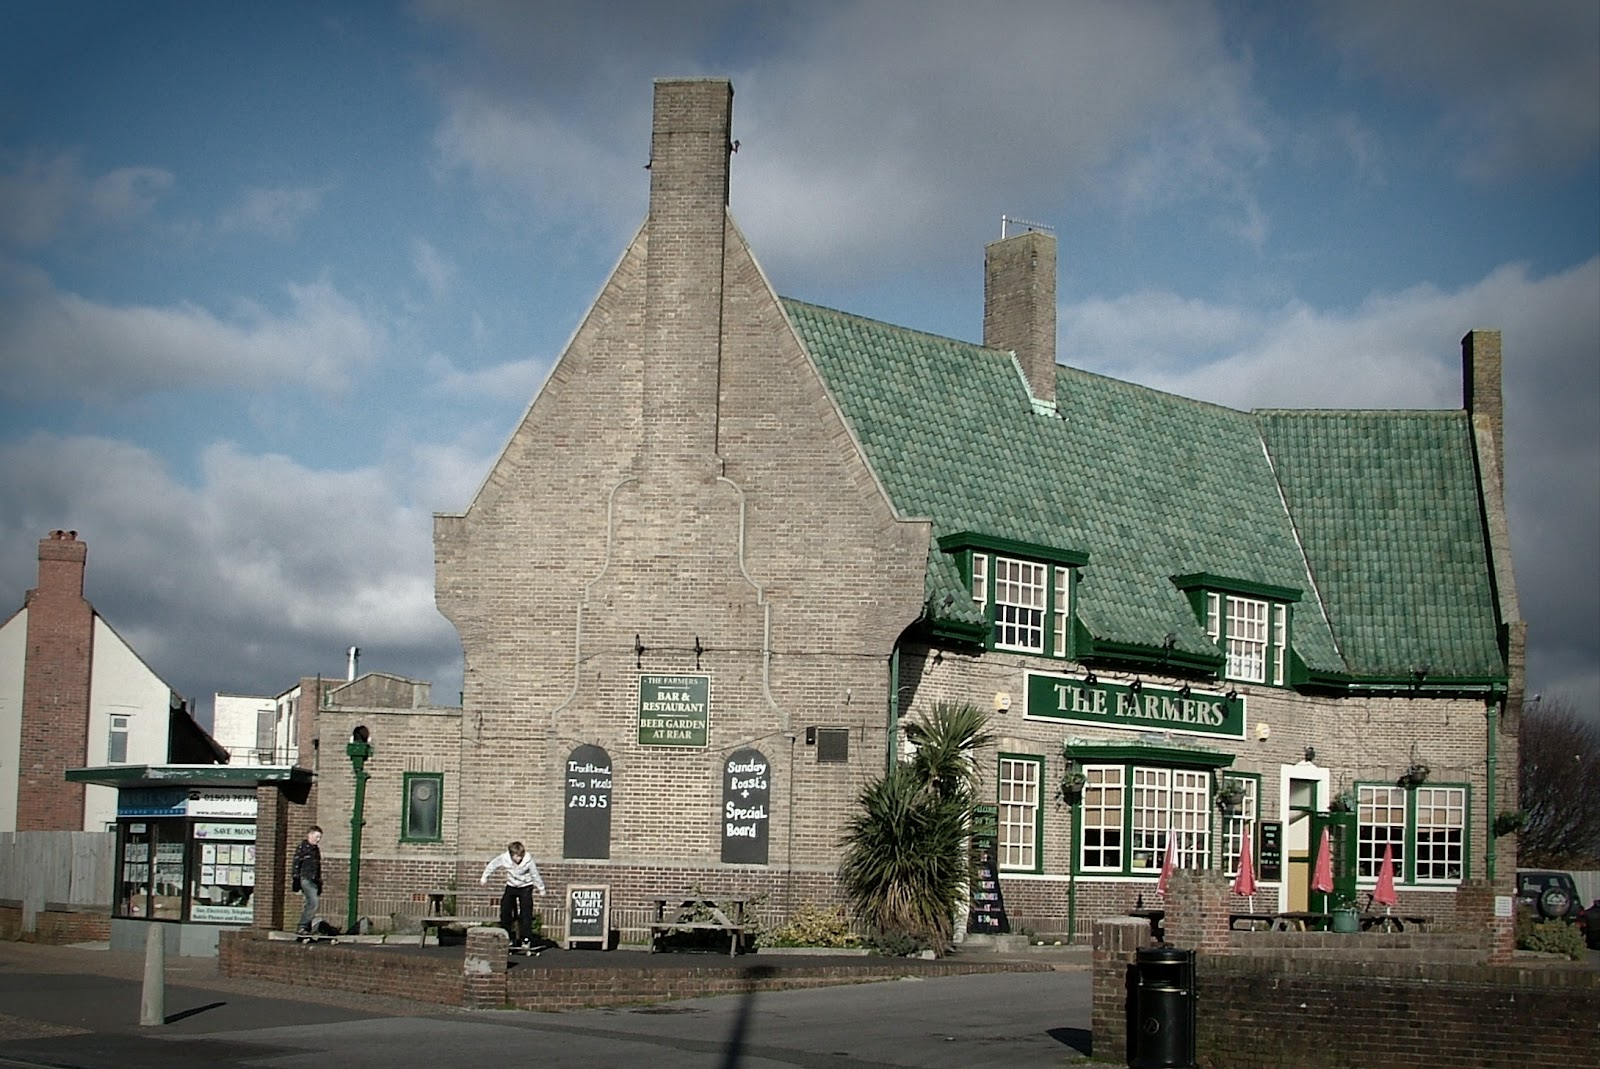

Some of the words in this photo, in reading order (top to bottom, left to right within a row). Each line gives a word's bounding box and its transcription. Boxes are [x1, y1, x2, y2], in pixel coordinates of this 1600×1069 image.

[648, 677, 662, 685] THE
[663, 677, 699, 685] FARMERS
[657, 691, 680, 701] BAR
[681, 692, 691, 701] &
[642, 702, 705, 712] RESTAURANT
[1054, 683, 1108, 715] THE
[1115, 691, 1224, 727] FARMERS
[640, 718, 665, 728] BEER
[665, 719, 706, 729] GARDEN
[653, 730, 665, 739] AT
[666, 730, 692, 739] REAR
[727, 758, 767, 775] Sunday
[568, 779, 586, 788] Two
[590, 778, 612, 789] Meals
[568, 794, 608, 808] £9.95
[726, 822, 757, 838] Board
[572, 890, 603, 900] CURRY
